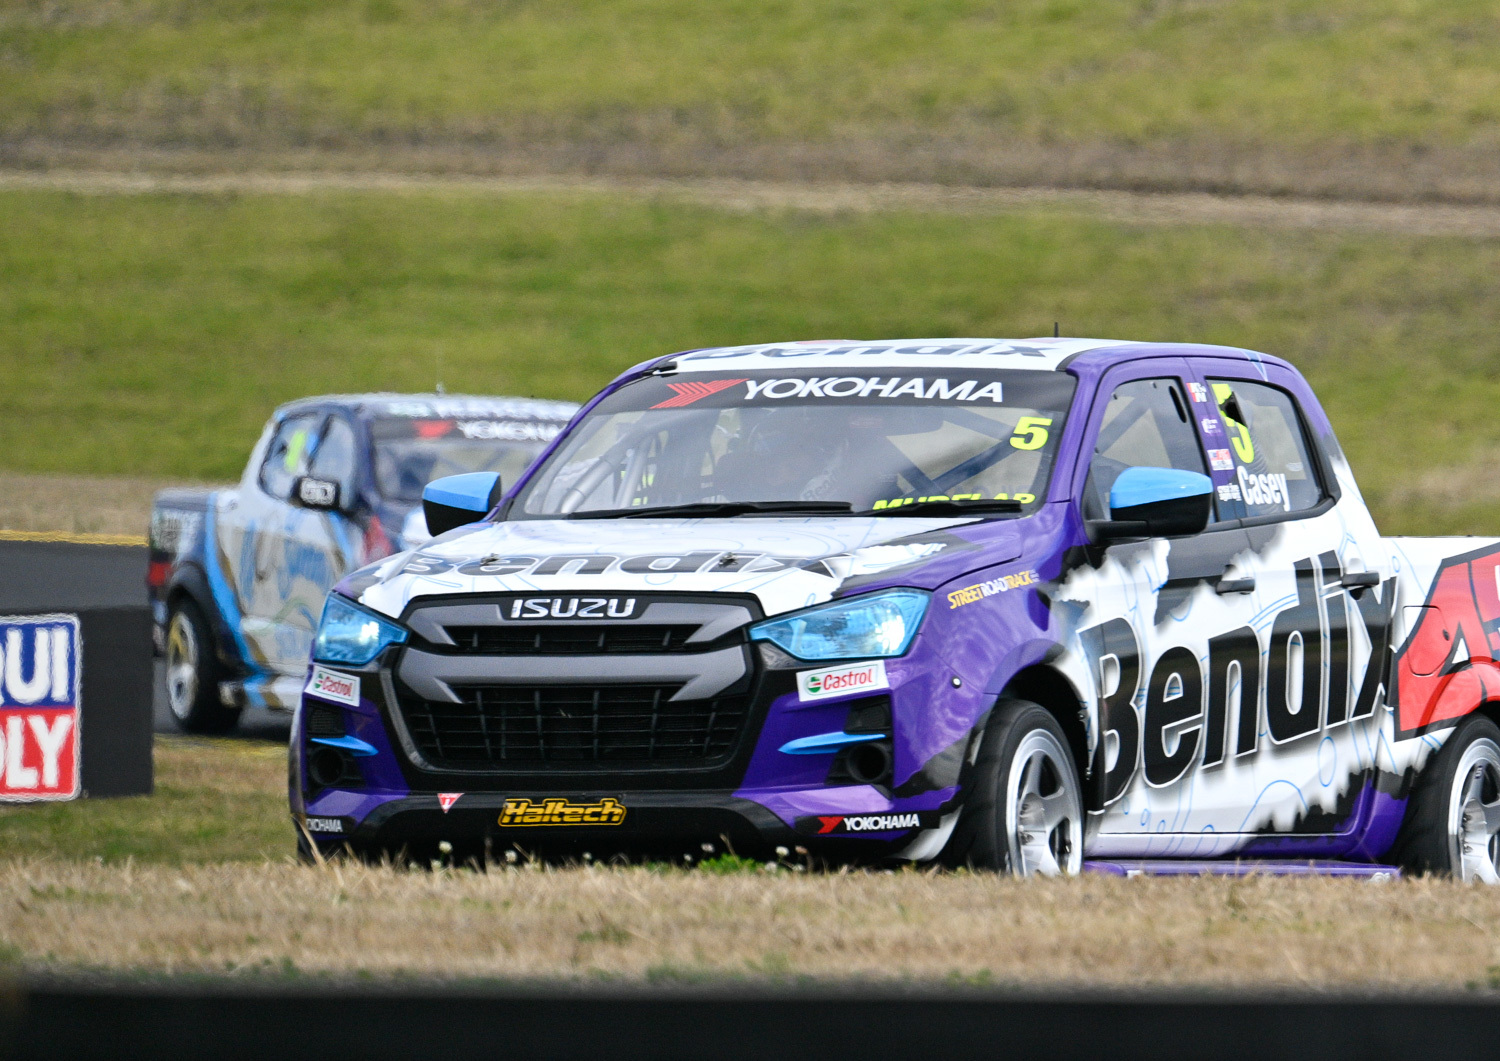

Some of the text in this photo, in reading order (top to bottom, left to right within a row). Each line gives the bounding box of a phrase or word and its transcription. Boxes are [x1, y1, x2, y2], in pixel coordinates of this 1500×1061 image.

[743, 376, 1002, 403] YOKOHAMA
[1010, 416, 1053, 450] 5
[1211, 383, 1254, 464] 5
[1237, 465, 1291, 512] Casey
[510, 598, 637, 619] ISUZU
[0, 625, 71, 705] UI
[823, 668, 874, 691] Castrol
[1077, 549, 1398, 806] Bendix
[0, 714, 74, 789] LY
[499, 799, 625, 826] Haltech
[844, 813, 920, 832] YOKOHAMA
